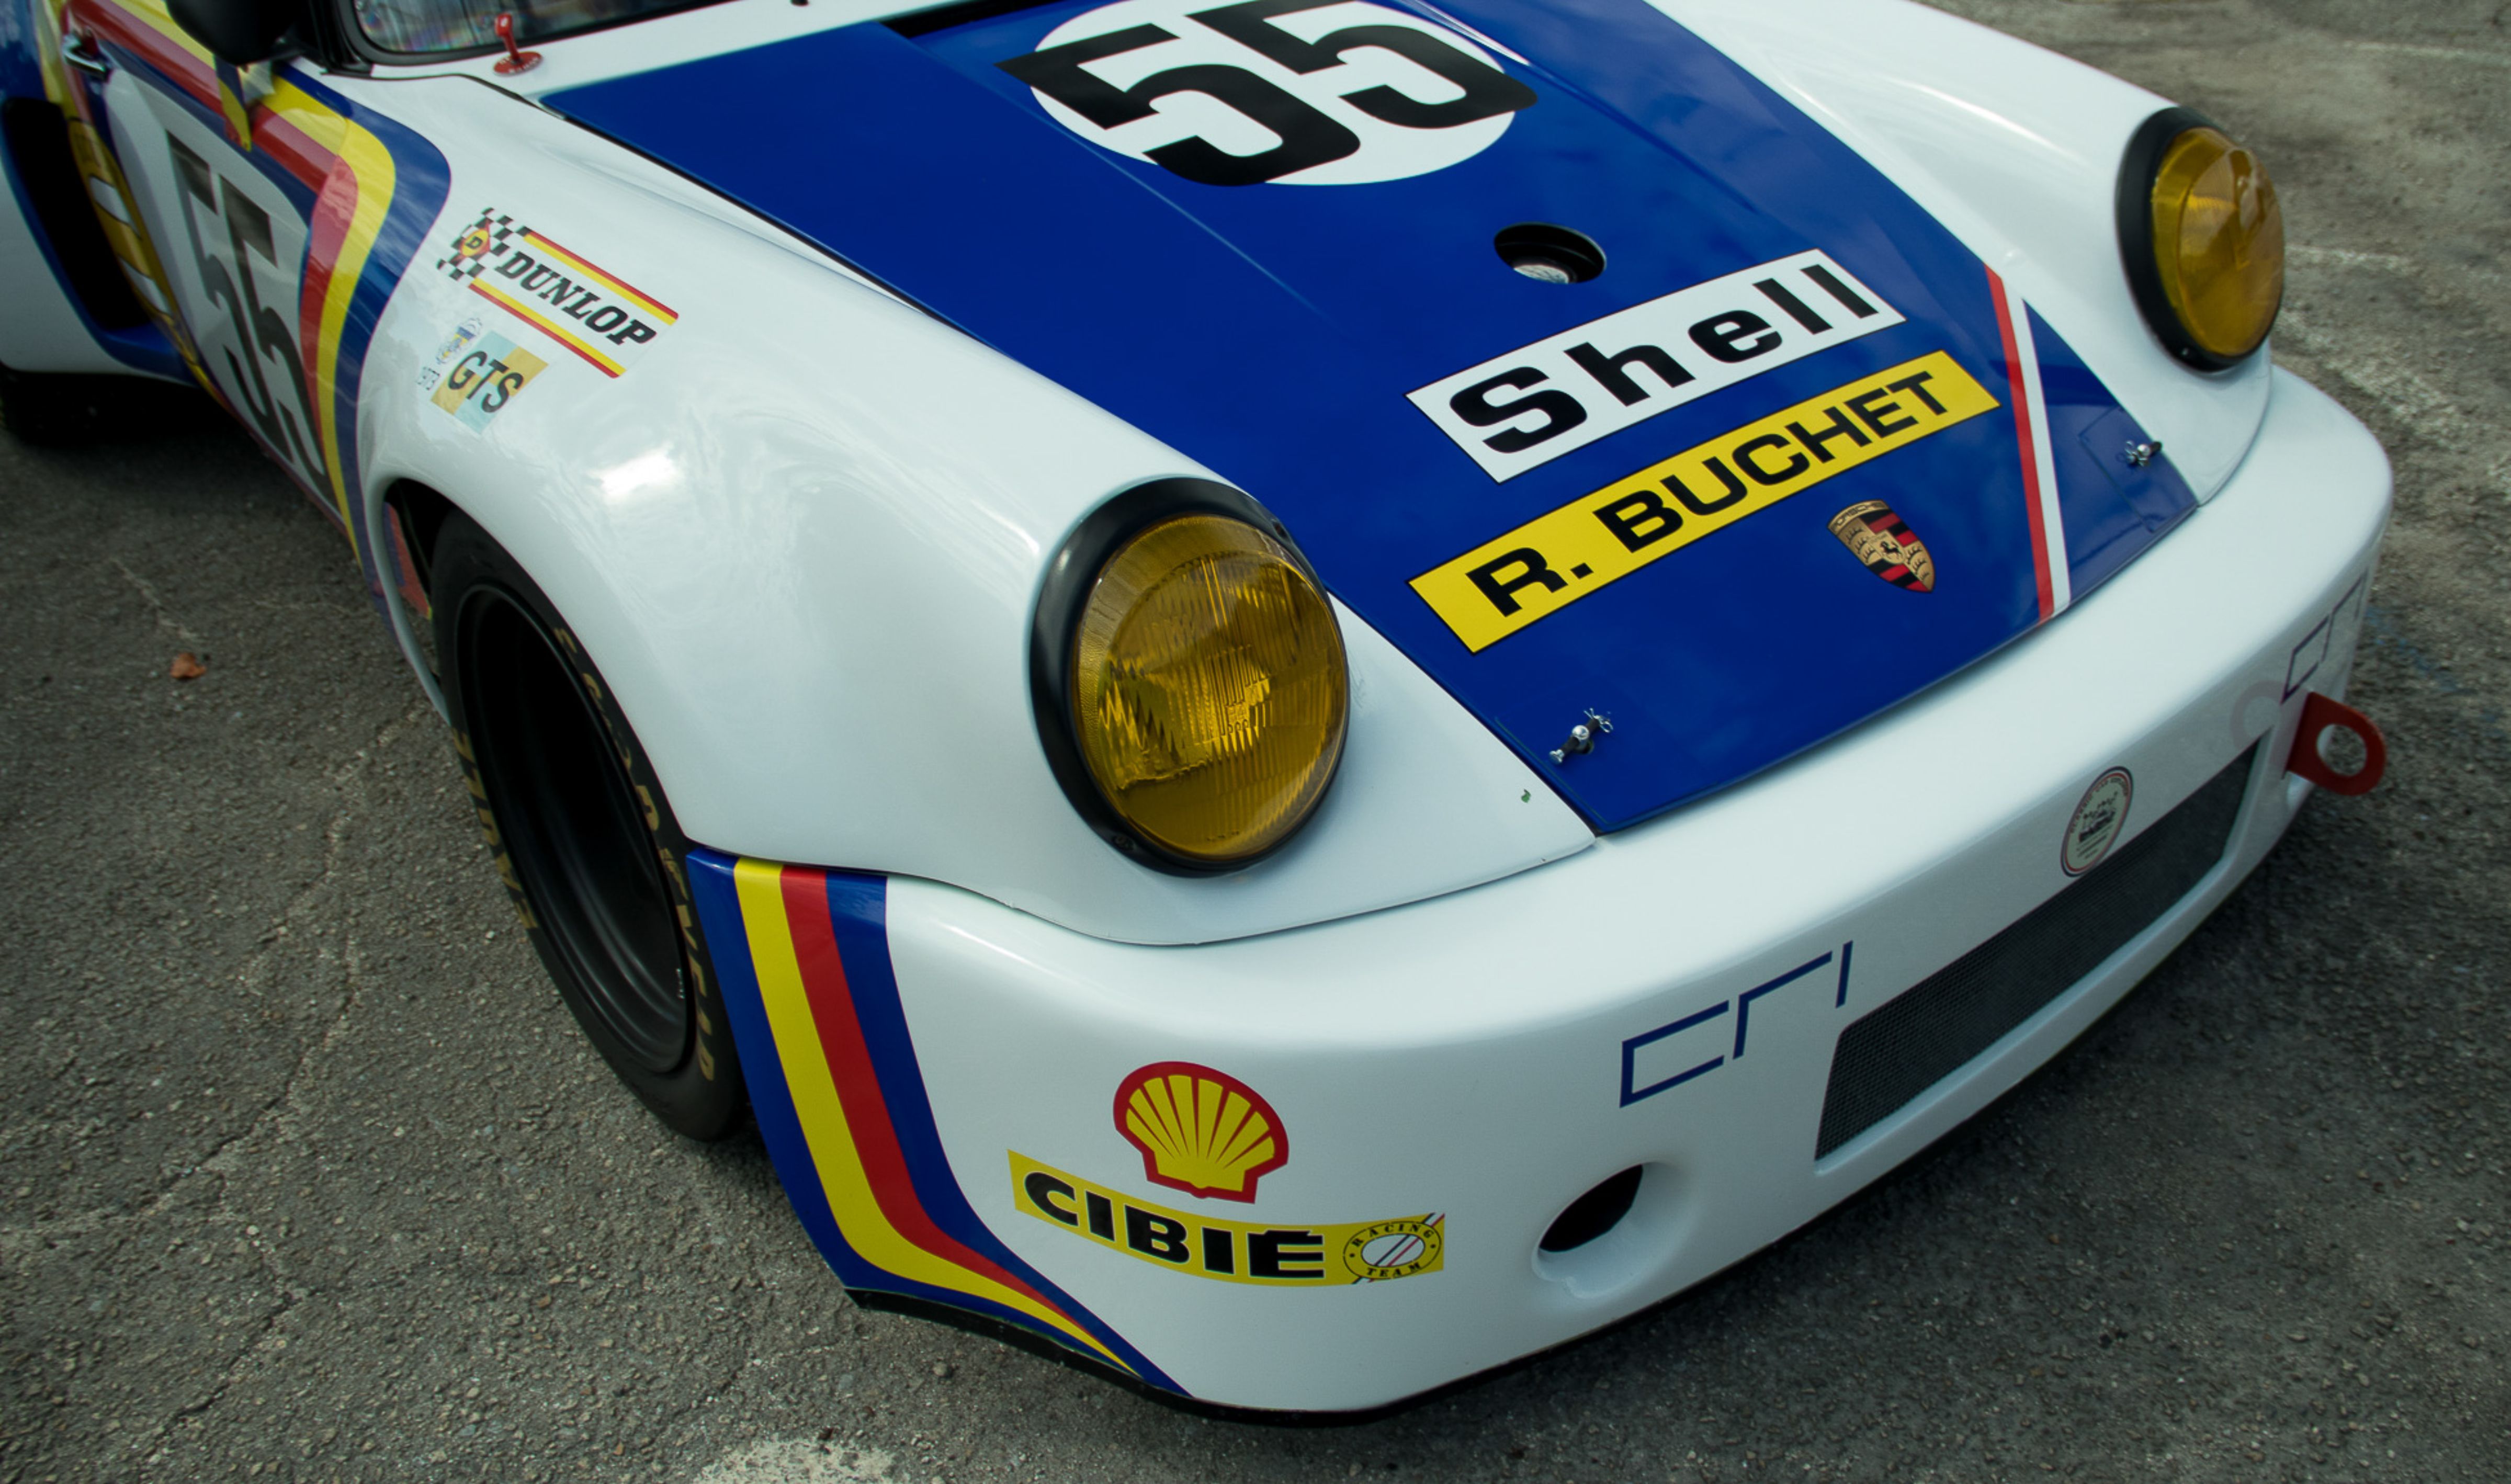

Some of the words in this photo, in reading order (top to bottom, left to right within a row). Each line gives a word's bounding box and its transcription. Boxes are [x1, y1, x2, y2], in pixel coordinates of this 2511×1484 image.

[993, 0, 1538, 186] 55
[465, 235, 483, 250] D
[165, 129, 343, 518] 55
[494, 251, 657, 345] DUNLOP
[448, 350, 524, 413] GTS
[1449, 264, 1880, 454] Shell
[1465, 547, 1594, 617] R.
[1592, 371, 1948, 553] BUCHET
[1352, 1224, 1434, 1248] RACING
[1367, 1261, 1421, 1277] TEAM
